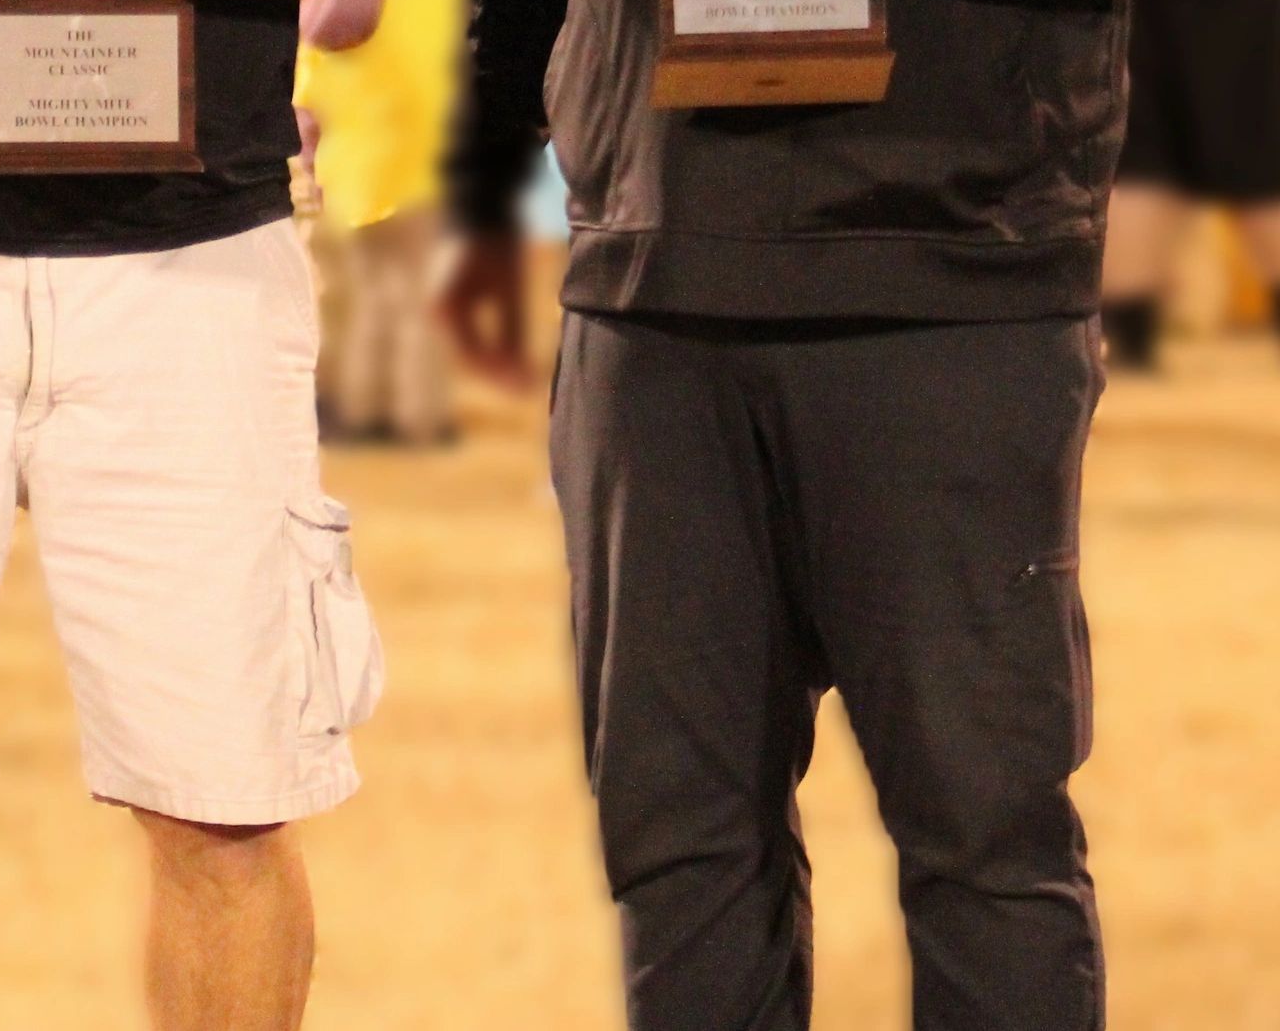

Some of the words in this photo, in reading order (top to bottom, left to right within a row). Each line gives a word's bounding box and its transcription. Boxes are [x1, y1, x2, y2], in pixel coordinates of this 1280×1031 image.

[753, 3, 837, 17] CHAMPION
[67, 30, 95, 42] THE
[24, 47, 138, 59] MOUNTAINEER
[48, 65, 110, 77] CLASSIC
[28, 99, 90, 111] MIGHTY
[95, 98, 136, 111] MITE
[15, 116, 61, 129] BOWL
[64, 116, 148, 128] CHAMPION
